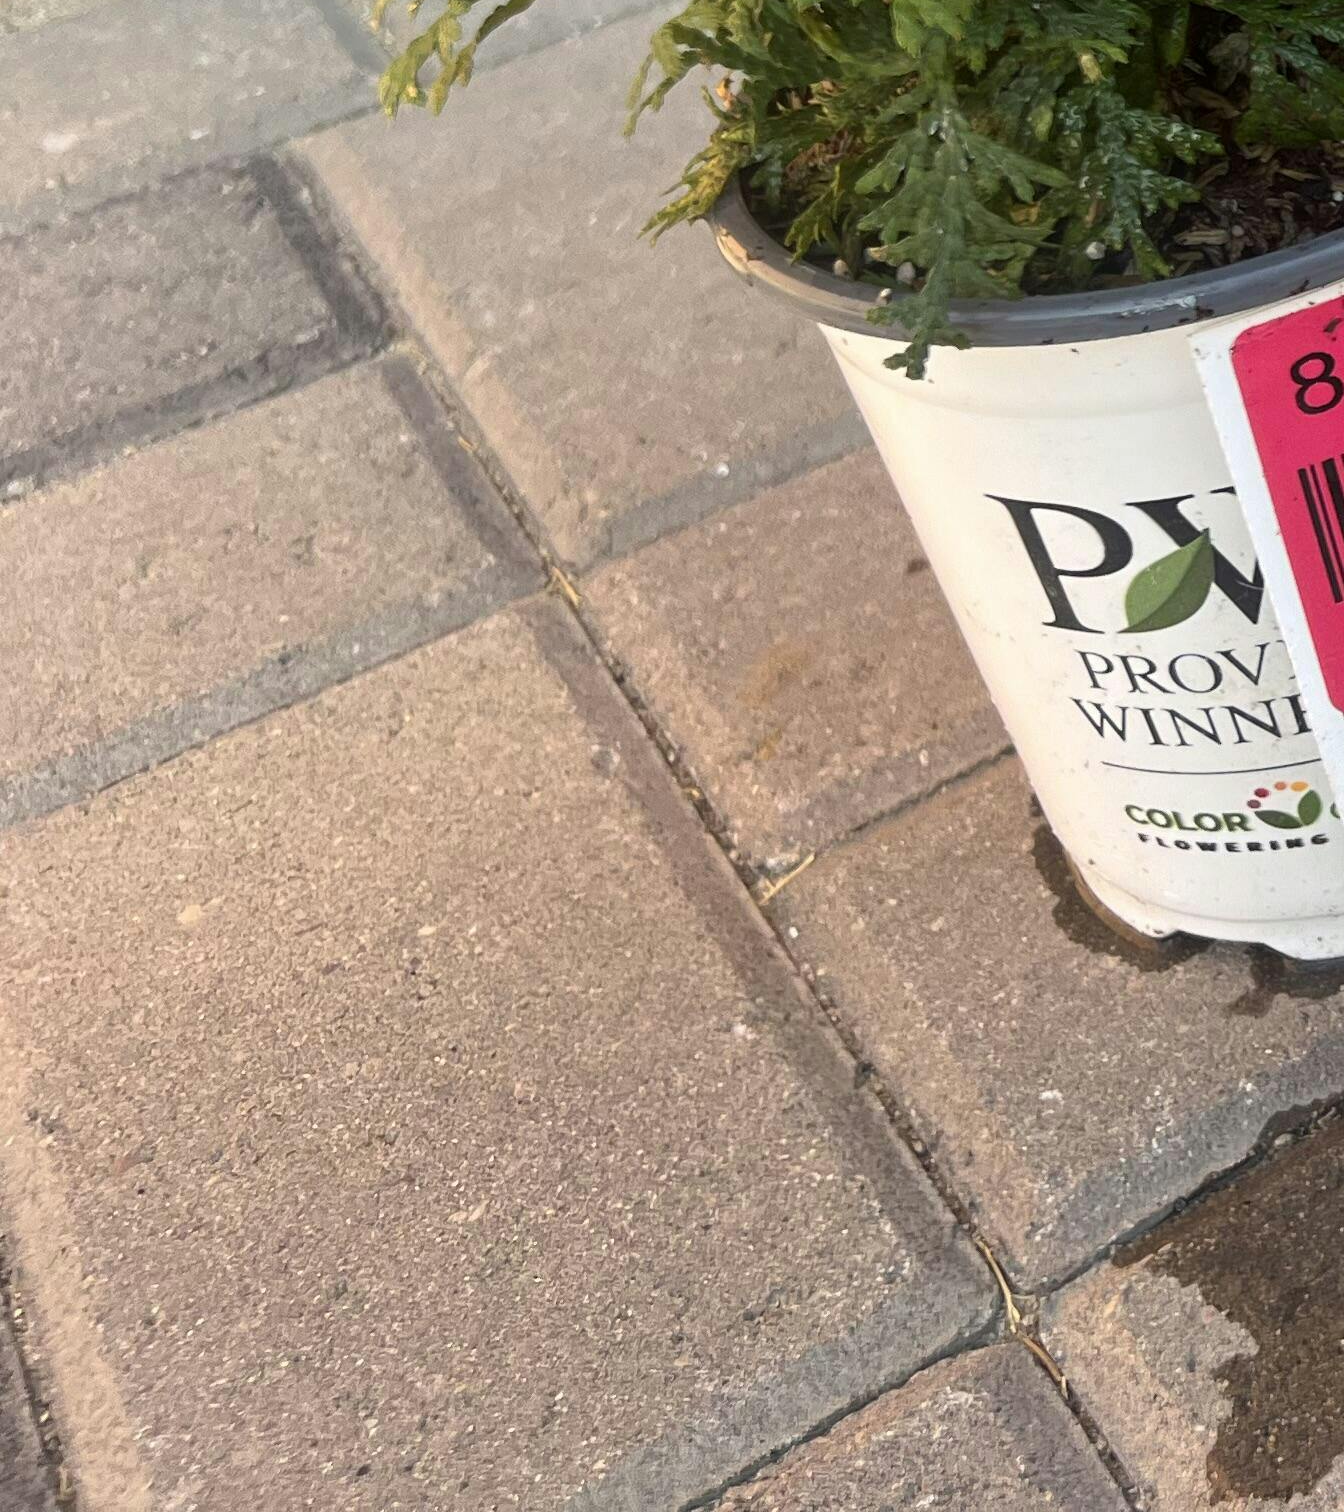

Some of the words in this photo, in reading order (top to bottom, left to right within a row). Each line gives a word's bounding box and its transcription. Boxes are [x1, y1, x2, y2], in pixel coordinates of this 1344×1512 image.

[1073, 640, 1296, 694] PROV
[1124, 804, 1254, 832] COLOR
[1137, 833, 1330, 852] FLOWERING
